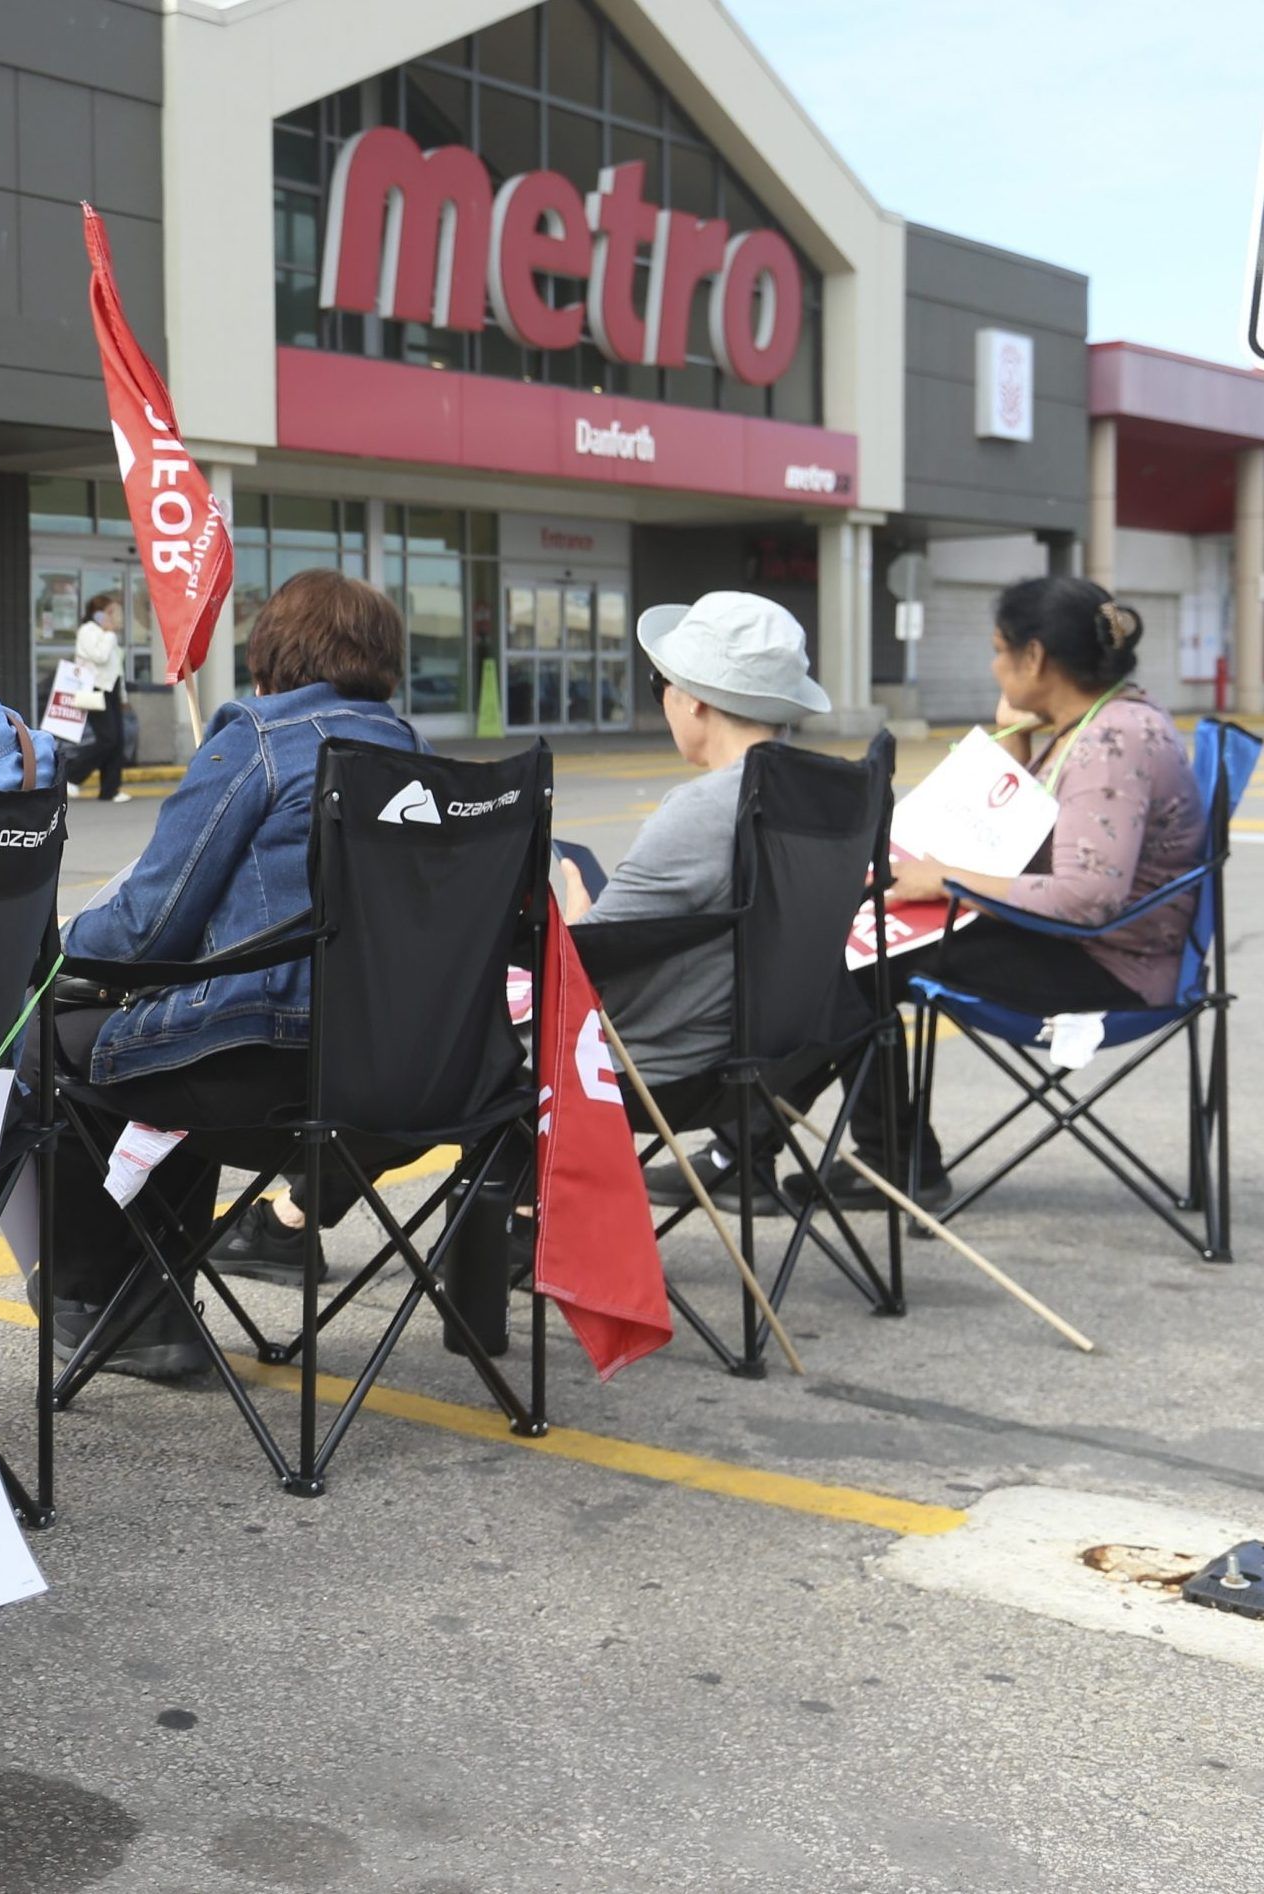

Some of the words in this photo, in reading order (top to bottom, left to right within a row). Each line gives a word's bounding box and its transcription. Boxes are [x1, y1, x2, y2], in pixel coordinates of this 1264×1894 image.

[319, 125, 804, 387] metro
[575, 418, 655, 463] Danforth
[541, 528, 594, 551] Entrance
[49, 704, 84, 721] STRIKE
[447, 800, 497, 817] OZARK
